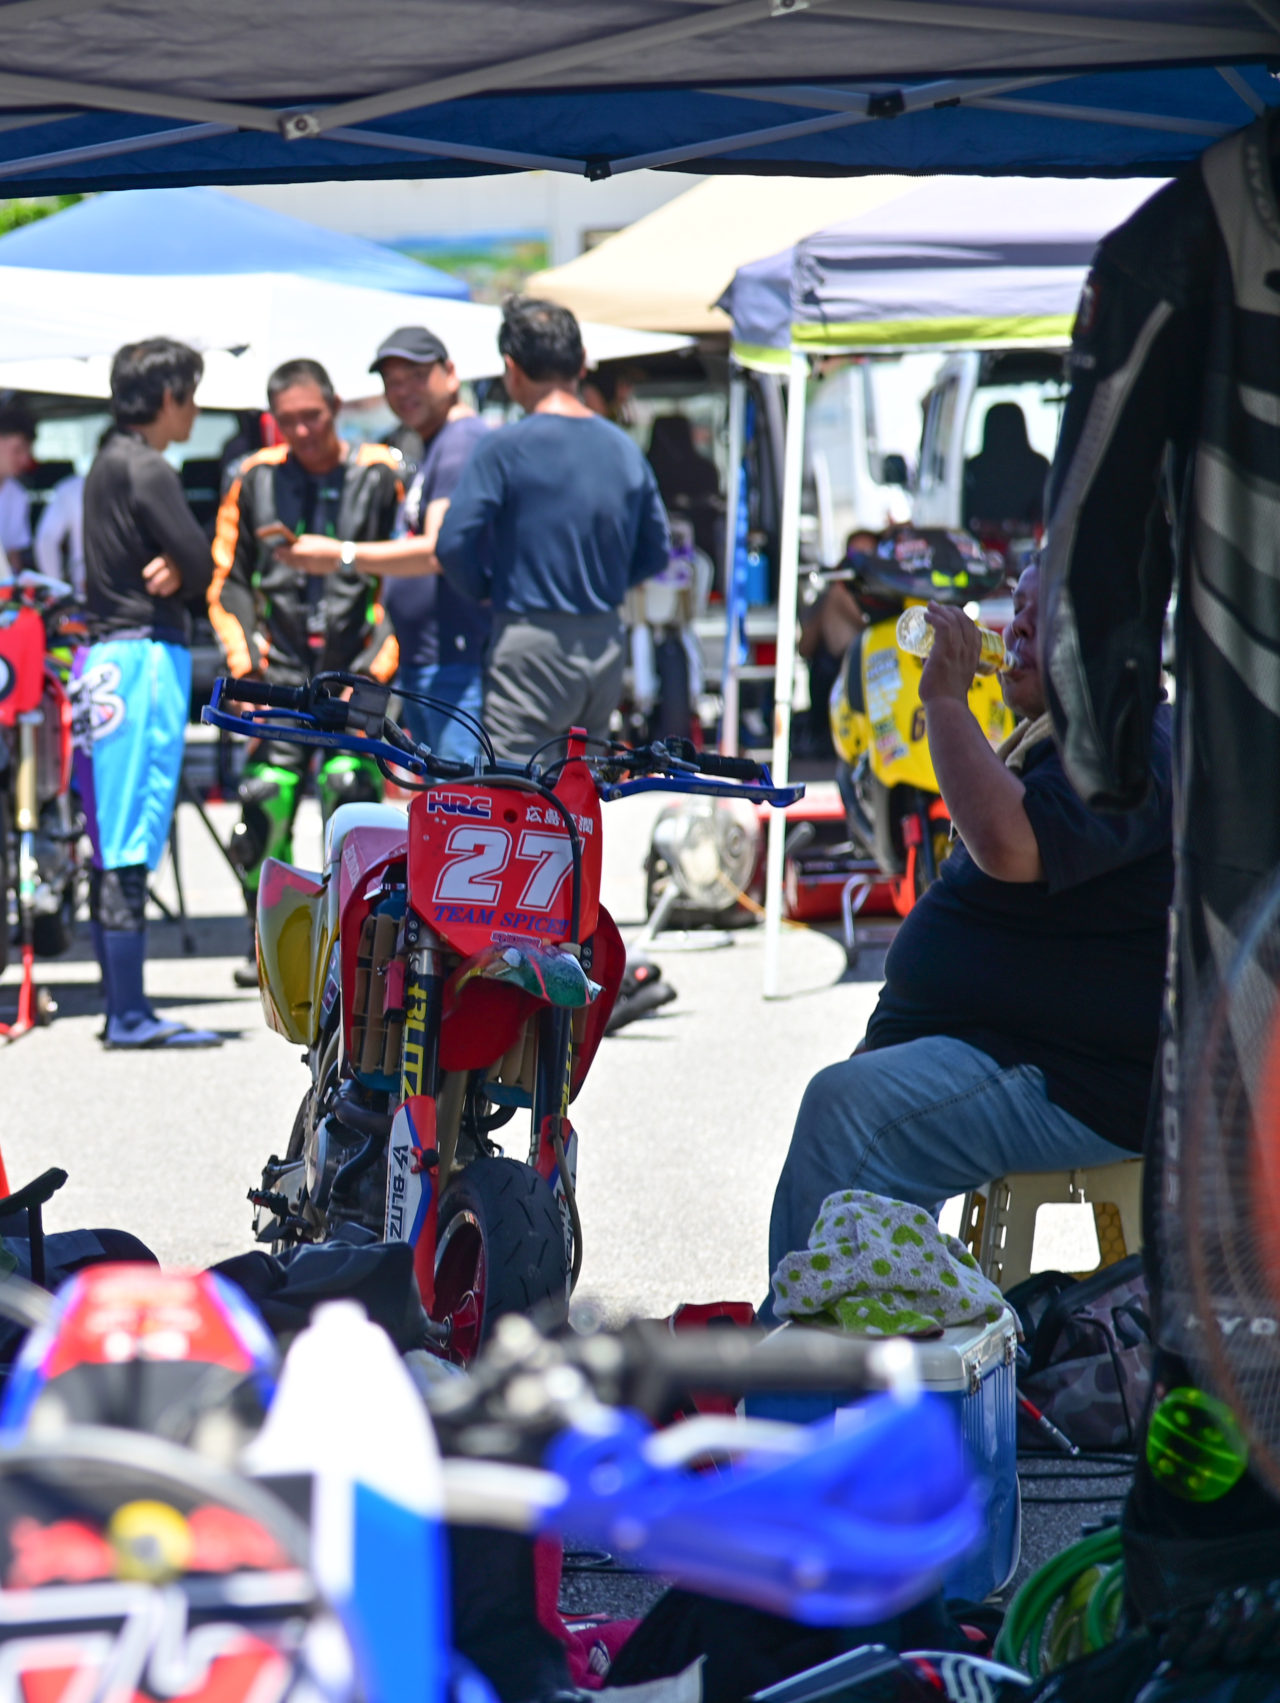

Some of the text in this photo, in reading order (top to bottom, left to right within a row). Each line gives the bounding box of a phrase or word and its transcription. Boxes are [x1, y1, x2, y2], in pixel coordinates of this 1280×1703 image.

[426, 791, 493, 820] HRC
[525, 805, 594, 836] 広島潤
[431, 824, 586, 913] 27
[433, 905, 497, 926] TEAM
[388, 1172, 406, 1241] BLITZ
